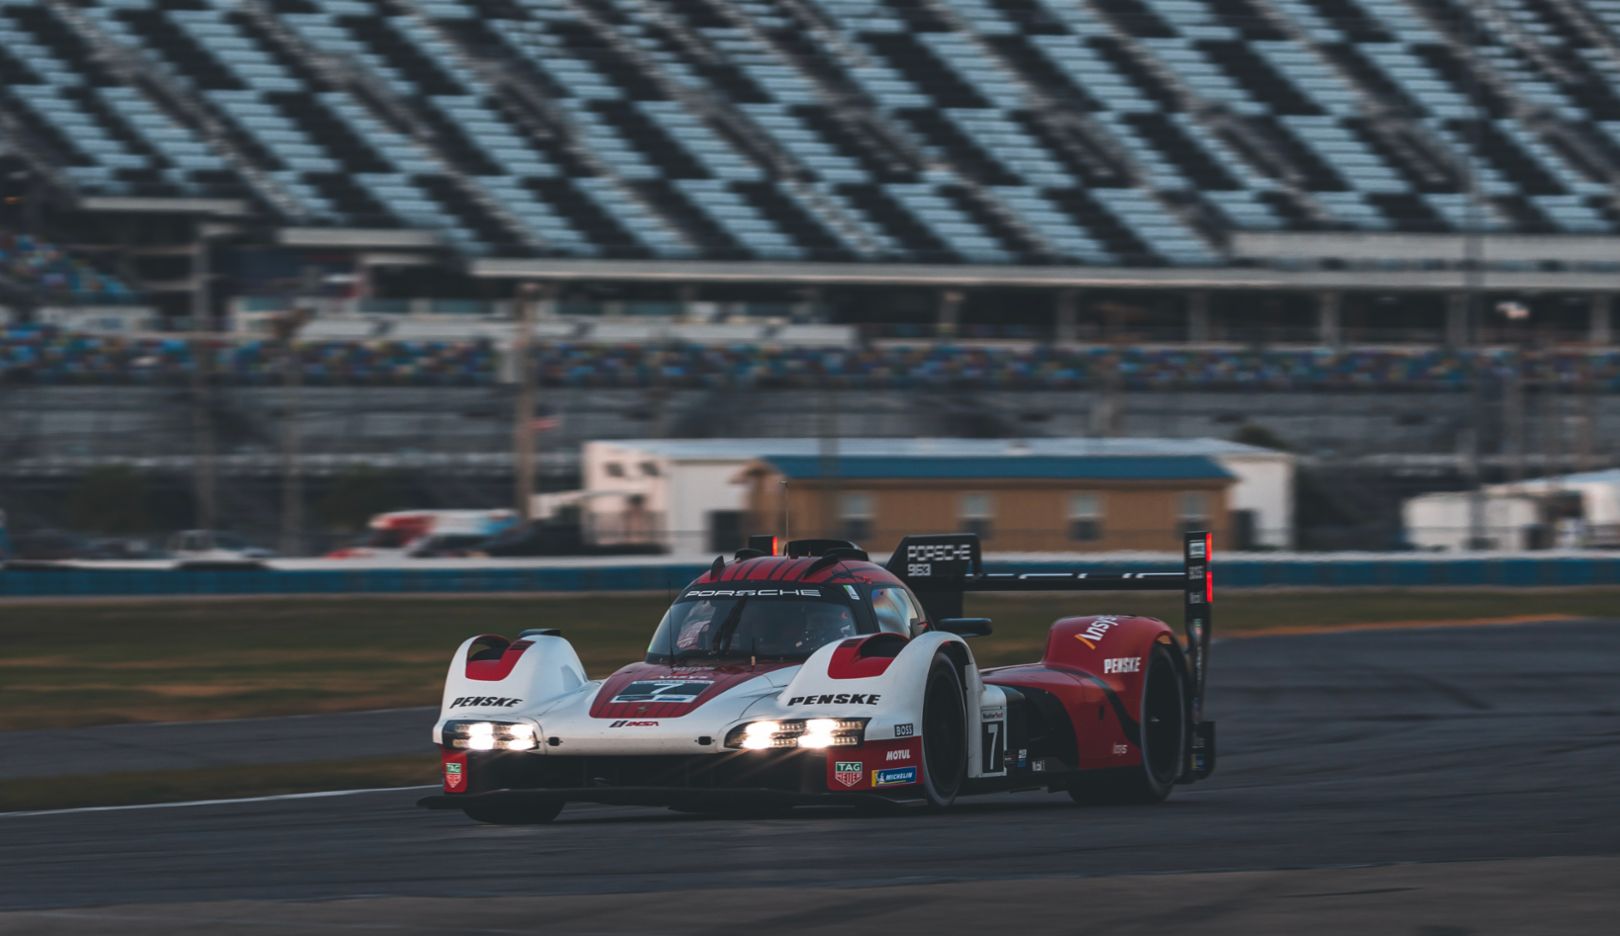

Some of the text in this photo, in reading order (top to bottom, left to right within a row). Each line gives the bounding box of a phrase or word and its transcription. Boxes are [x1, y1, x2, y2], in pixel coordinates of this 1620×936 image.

[907, 563, 931, 577] 963
[684, 589, 822, 598] PORSCHE
[1103, 656, 1142, 674] PENSKE
[650, 683, 684, 695] 7
[449, 696, 523, 709] PENSKE
[787, 693, 882, 706] PENSKE
[896, 725, 913, 736] BOSS
[987, 723, 998, 770] 7
[886, 749, 911, 761] MOTUL
[838, 763, 861, 772] TAG
[836, 772, 862, 785] HEUER
[885, 772, 913, 781] MICHELIN
